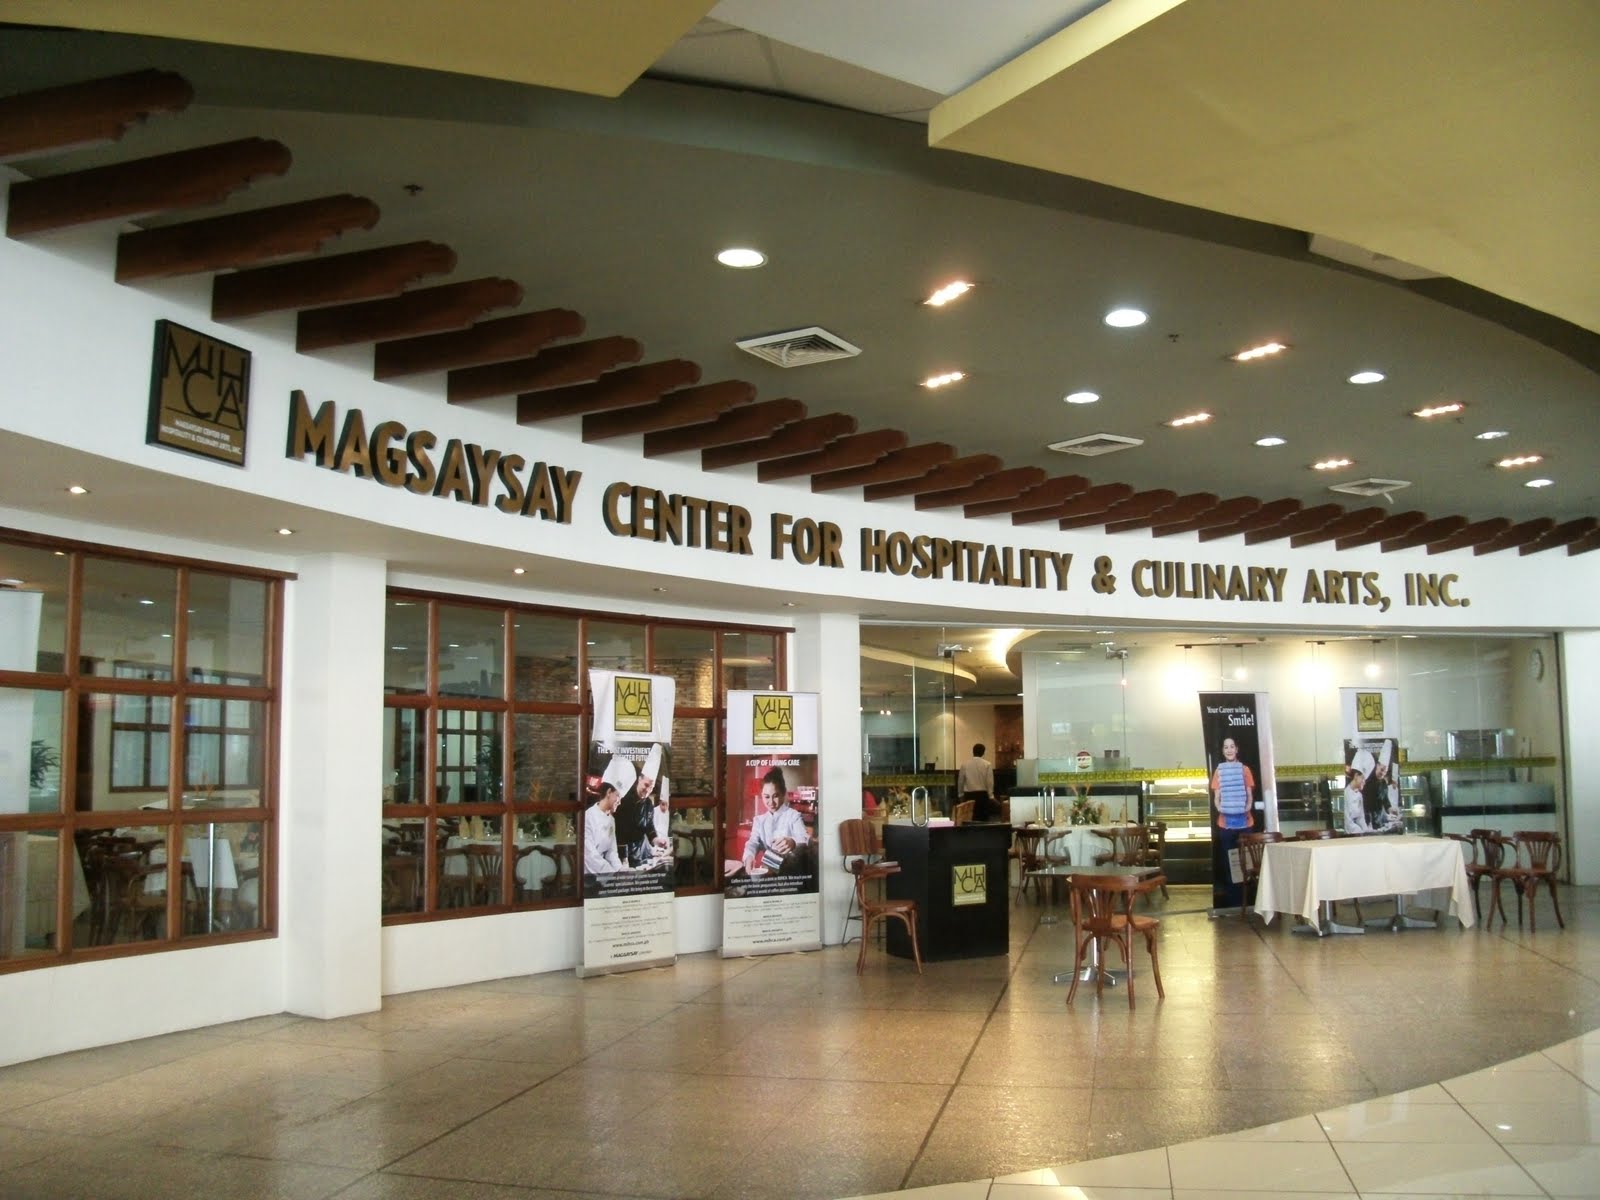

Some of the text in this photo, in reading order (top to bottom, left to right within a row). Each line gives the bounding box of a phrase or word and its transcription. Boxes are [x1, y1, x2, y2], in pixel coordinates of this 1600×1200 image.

[286, 389, 1470, 612] MAGSAYSAY CENTER FOR HOSPITALITY & CULINARY ARTS, INC.
[1228, 714, 1254, 726] Smile!
[788, 759, 800, 767] CARE
